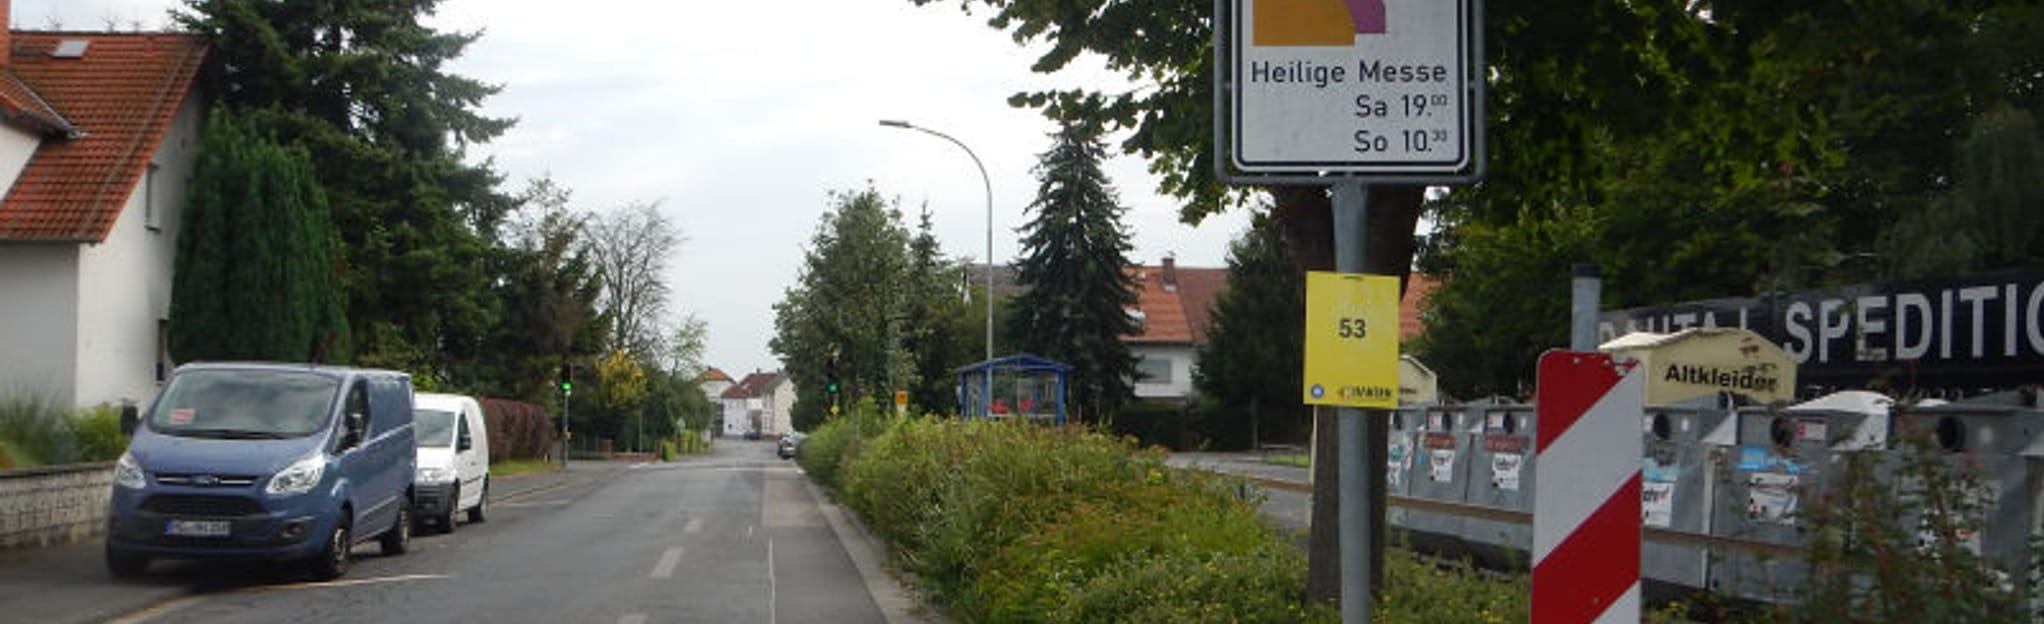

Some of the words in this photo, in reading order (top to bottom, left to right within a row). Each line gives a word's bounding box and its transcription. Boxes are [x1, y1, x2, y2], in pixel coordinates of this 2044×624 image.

[1251, 60, 1346, 88] Heilige
[1359, 60, 1447, 83] Messe
[1355, 94, 1388, 117] Sa
[1354, 130, 1388, 152] So
[1338, 318, 1367, 339] 53
[1664, 363, 1777, 392] Altkleider
